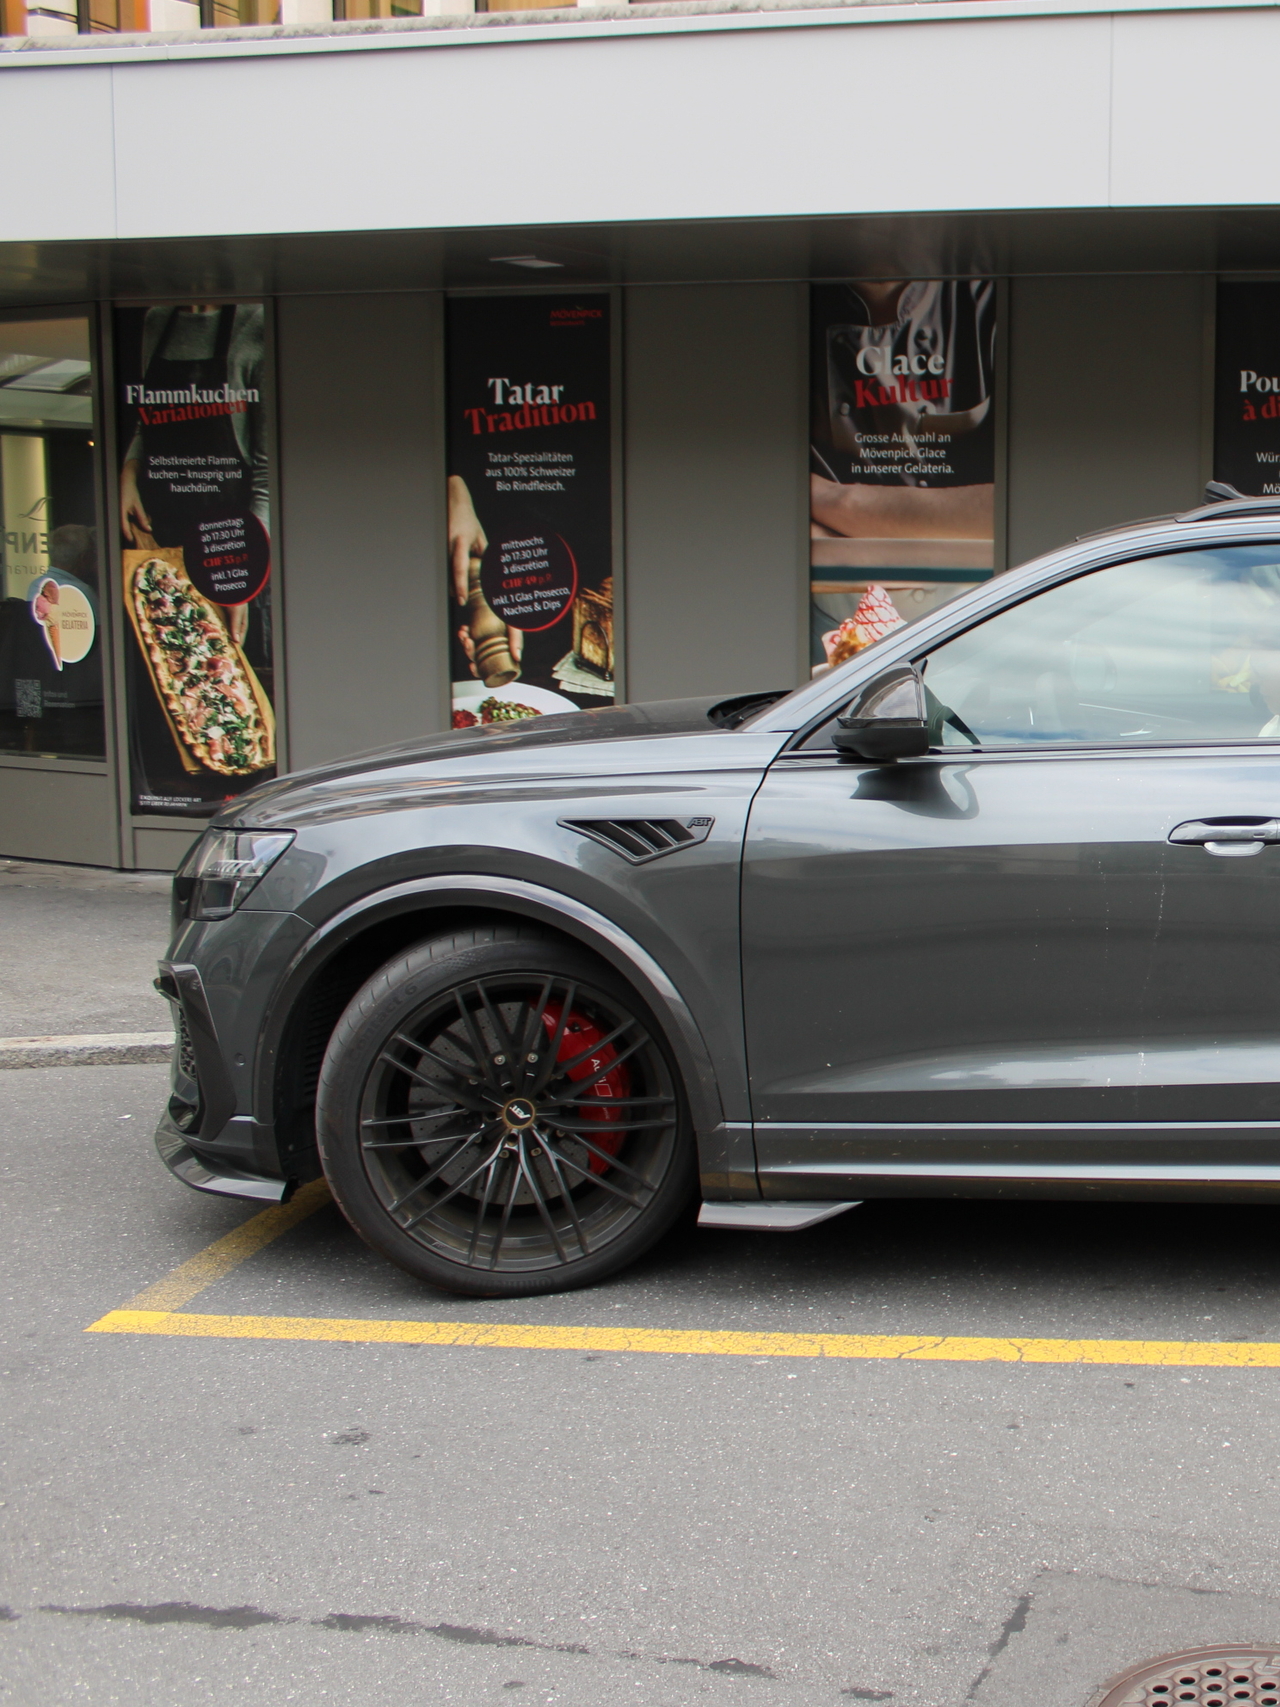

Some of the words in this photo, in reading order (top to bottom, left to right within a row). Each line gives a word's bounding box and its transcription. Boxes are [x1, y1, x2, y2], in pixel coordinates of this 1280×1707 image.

[856, 345, 945, 376] Glace
[125, 383, 260, 404] Flammkuchen
[487, 377, 564, 405] Tatar
[854, 374, 954, 408] Kultur
[137, 400, 248, 425] Variationen
[464, 399, 596, 435] Tradition
[854, 432, 889, 443] Grosse
[891, 432, 936, 442] Auswahl
[937, 433, 951, 442] an
[208, 455, 240, 465] Flamm-
[487, 452, 574, 465] Tatar-Spezialitäten
[860, 447, 914, 461] Mövenpick
[917, 447, 946, 458] Glace
[485, 468, 502, 477] aus
[503, 466, 529, 477] 100%
[529, 466, 576, 477] Schweizer
[851, 463, 861, 473] in
[863, 463, 903, 474] unserer
[904, 462, 955, 474] Gelateria.
[148, 469, 179, 479] kuchen
[187, 469, 224, 482] knusprig
[225, 469, 243, 479] und
[495, 480, 512, 491] Bio
[512, 479, 566, 491] Rindfleisch.
[231, 529, 245, 537] Uhr
[500, 554, 511, 563] ab
[532, 548, 548, 557] Uhr
[214, 581, 247, 592] Prosecco
[515, 592, 533, 602] Glas
[503, 604, 533, 616] Nachos
[533, 602, 542, 611] &
[542, 600, 561, 611] Dips
